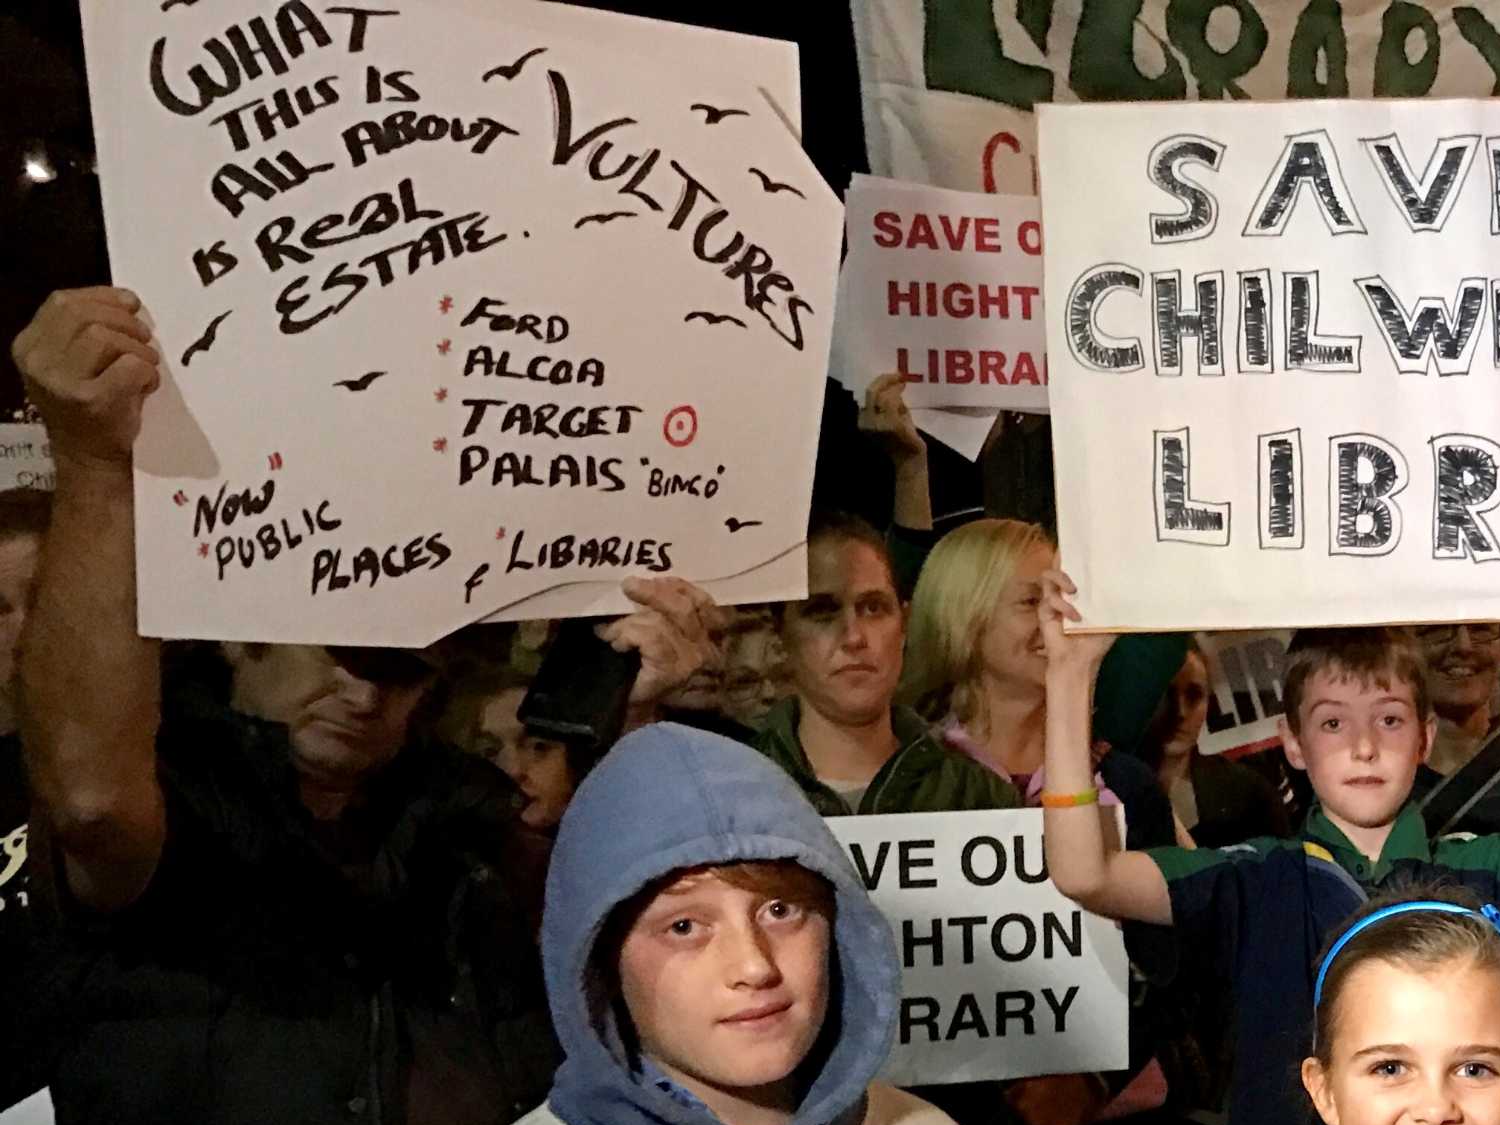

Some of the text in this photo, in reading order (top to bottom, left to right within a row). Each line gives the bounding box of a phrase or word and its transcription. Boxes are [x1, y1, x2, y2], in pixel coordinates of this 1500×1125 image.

[149, 0, 400, 116] WHAT
[209, 65, 420, 151] THIS IS
[341, 110, 520, 167] ABOUT
[873, 212, 1002, 253] SAVE
[887, 280, 1040, 321] HIGHT
[463, 345, 605, 386] ALCOA
[896, 347, 1049, 385] LIBRA
[462, 400, 643, 439] TARGET
[459, 445, 626, 492] PALAIS
[215, 500, 342, 580] PUBLIC
[312, 530, 673, 596] PLACES LIBARIES
[849, 835, 1050, 891] VE OU
[902, 910, 1083, 967] HTON
[900, 985, 1080, 1044] RARY
